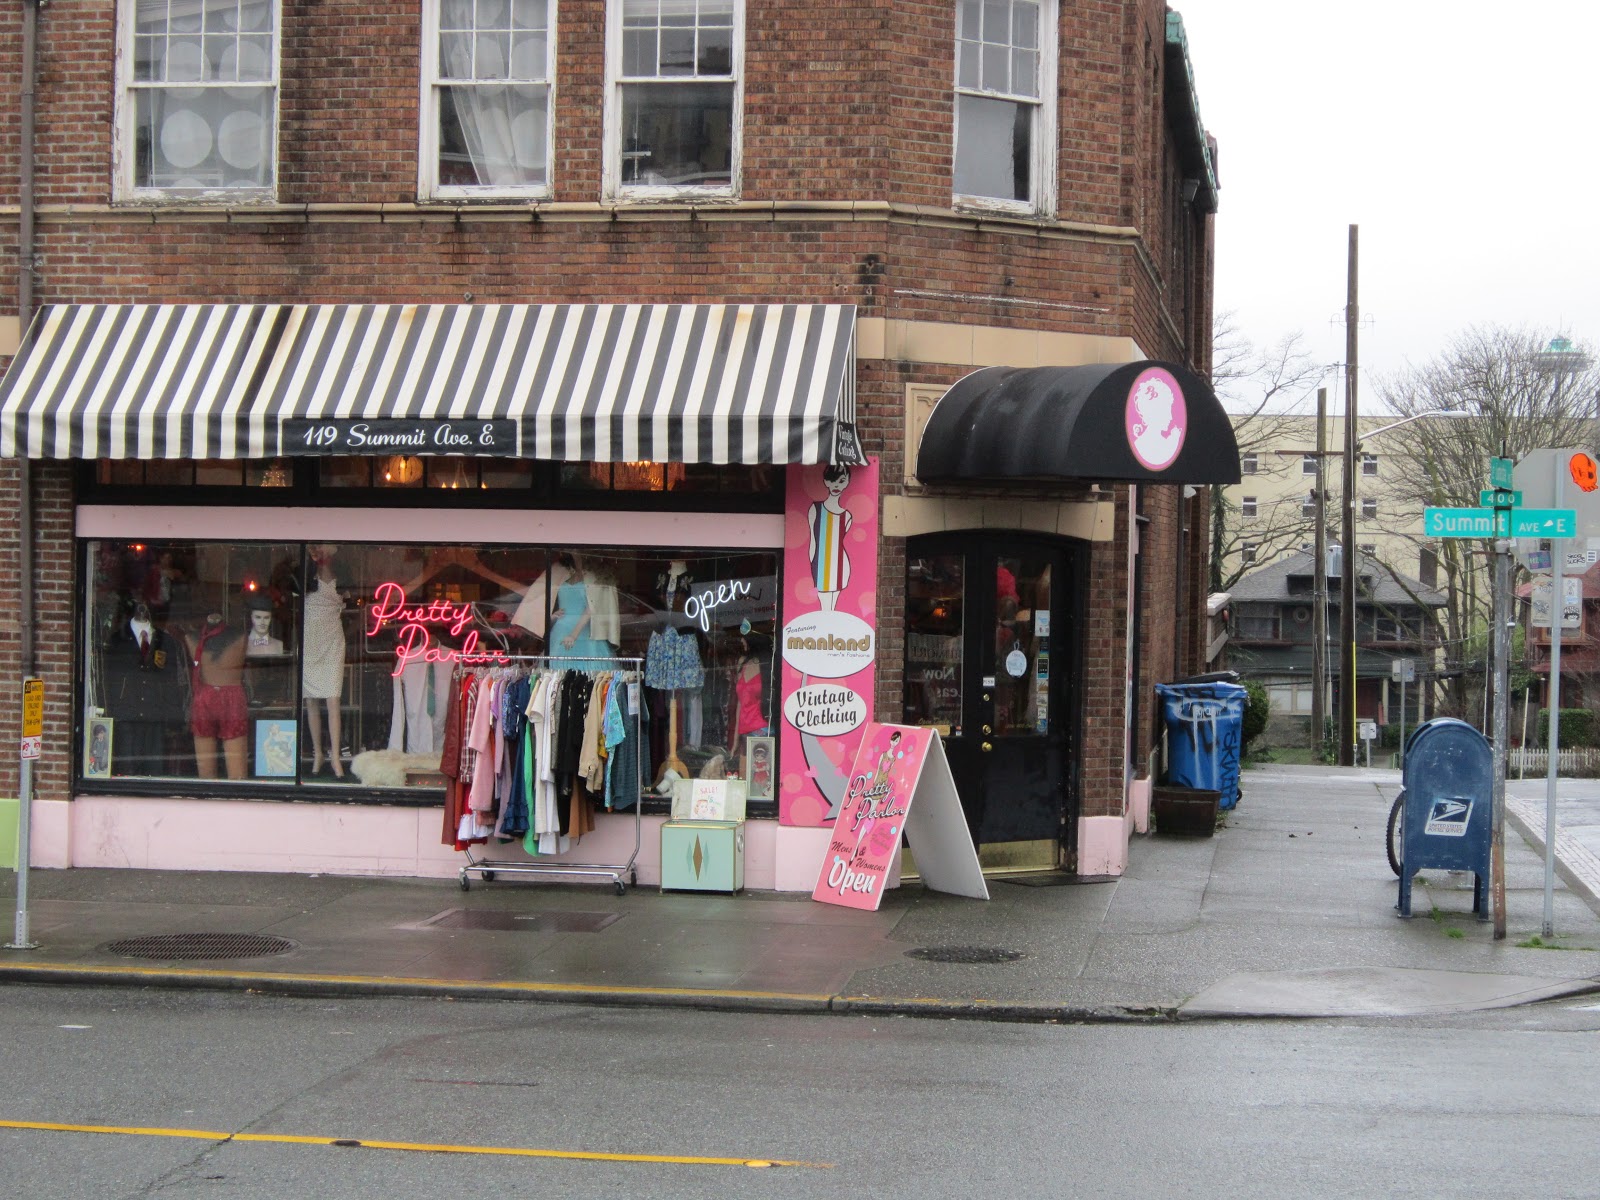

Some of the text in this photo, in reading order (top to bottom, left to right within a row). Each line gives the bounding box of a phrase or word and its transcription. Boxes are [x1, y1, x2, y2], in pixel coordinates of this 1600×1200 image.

[303, 426, 338, 446] 119
[347, 423, 426, 447] Summit
[1487, 493, 1515, 504] 400
[1433, 513, 1567, 533] Summit AVE E
[366, 582, 474, 637] Pretty
[685, 580, 751, 632] open
[786, 624, 817, 635] Featuring
[391, 623, 510, 677] Parlor
[787, 633, 871, 652] manland
[796, 688, 855, 708] Vintage
[795, 707, 857, 728] Clothing
[844, 775, 894, 810] Pretty
[850, 796, 906, 832] Parlor
[831, 841, 867, 857] Mens &
[855, 857, 886, 872] Womens
[827, 859, 877, 896] Open
